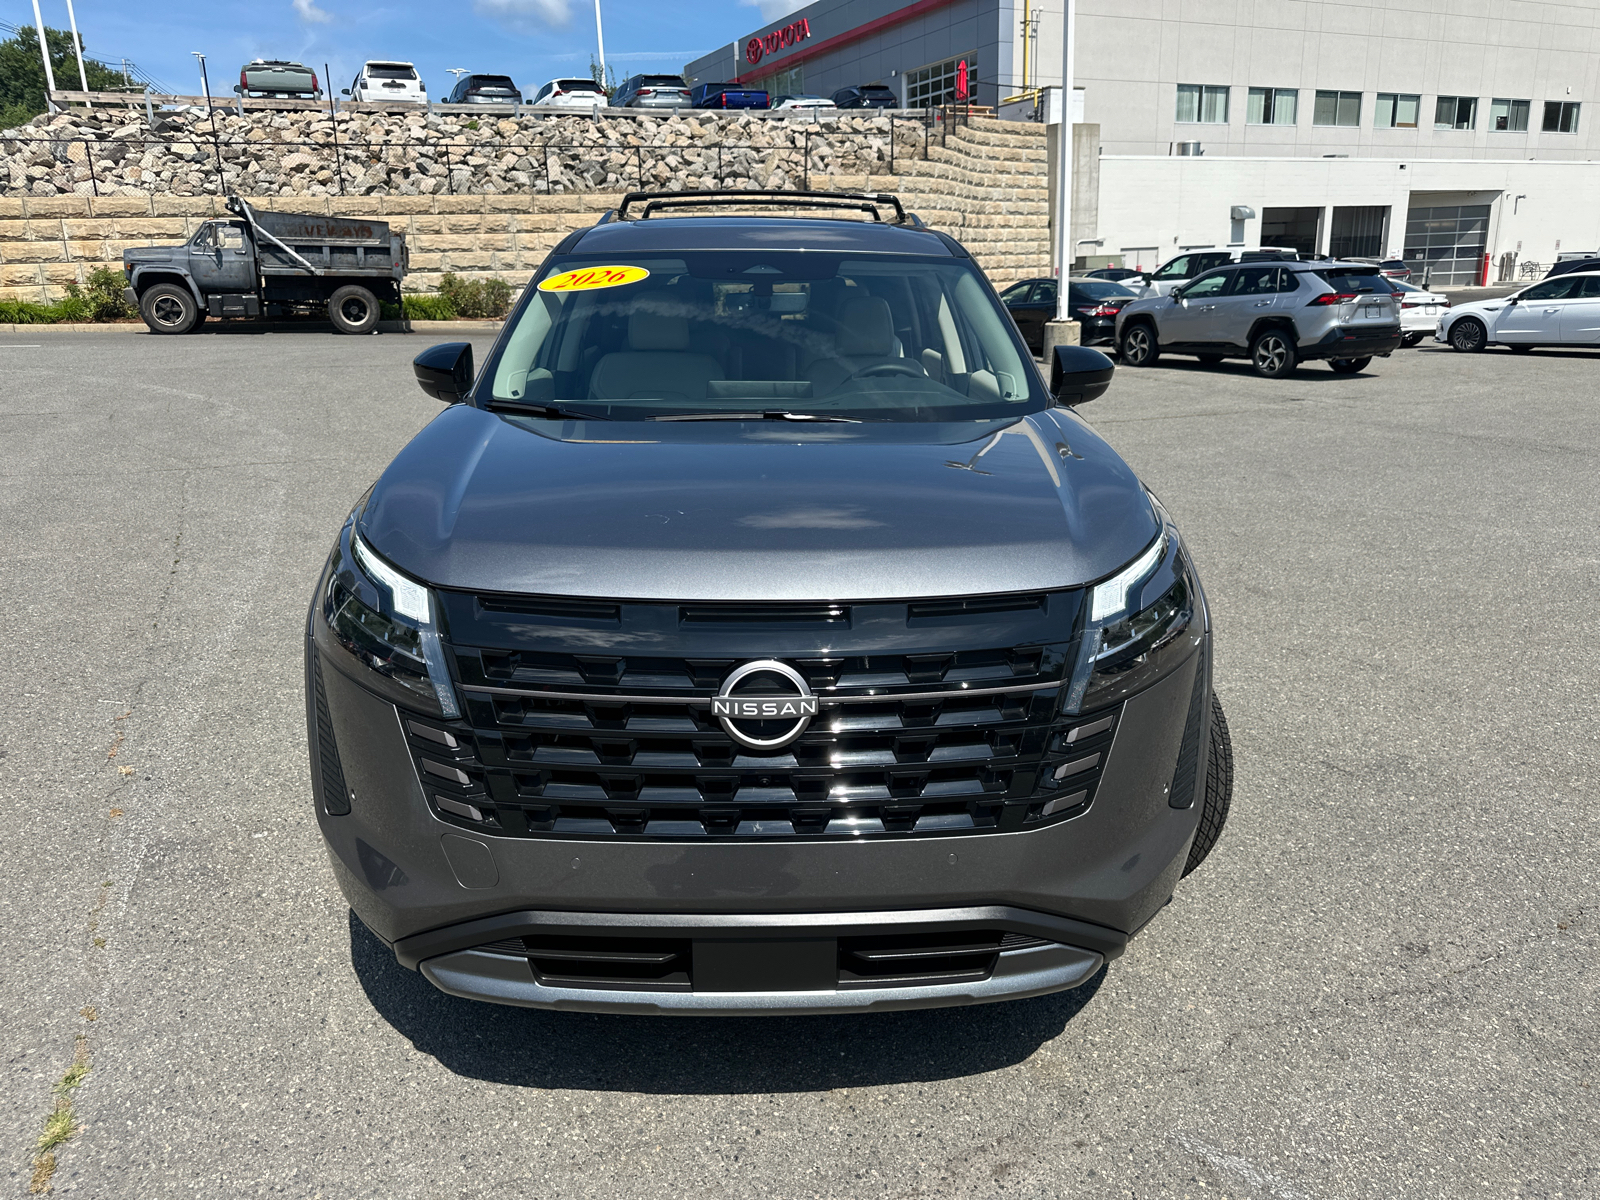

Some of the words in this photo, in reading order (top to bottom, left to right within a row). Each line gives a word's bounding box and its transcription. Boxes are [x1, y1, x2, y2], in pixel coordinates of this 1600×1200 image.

[762, 18, 811, 55] TOYOTA
[553, 268, 633, 289] 2026
[714, 700, 816, 716] NISSAN
